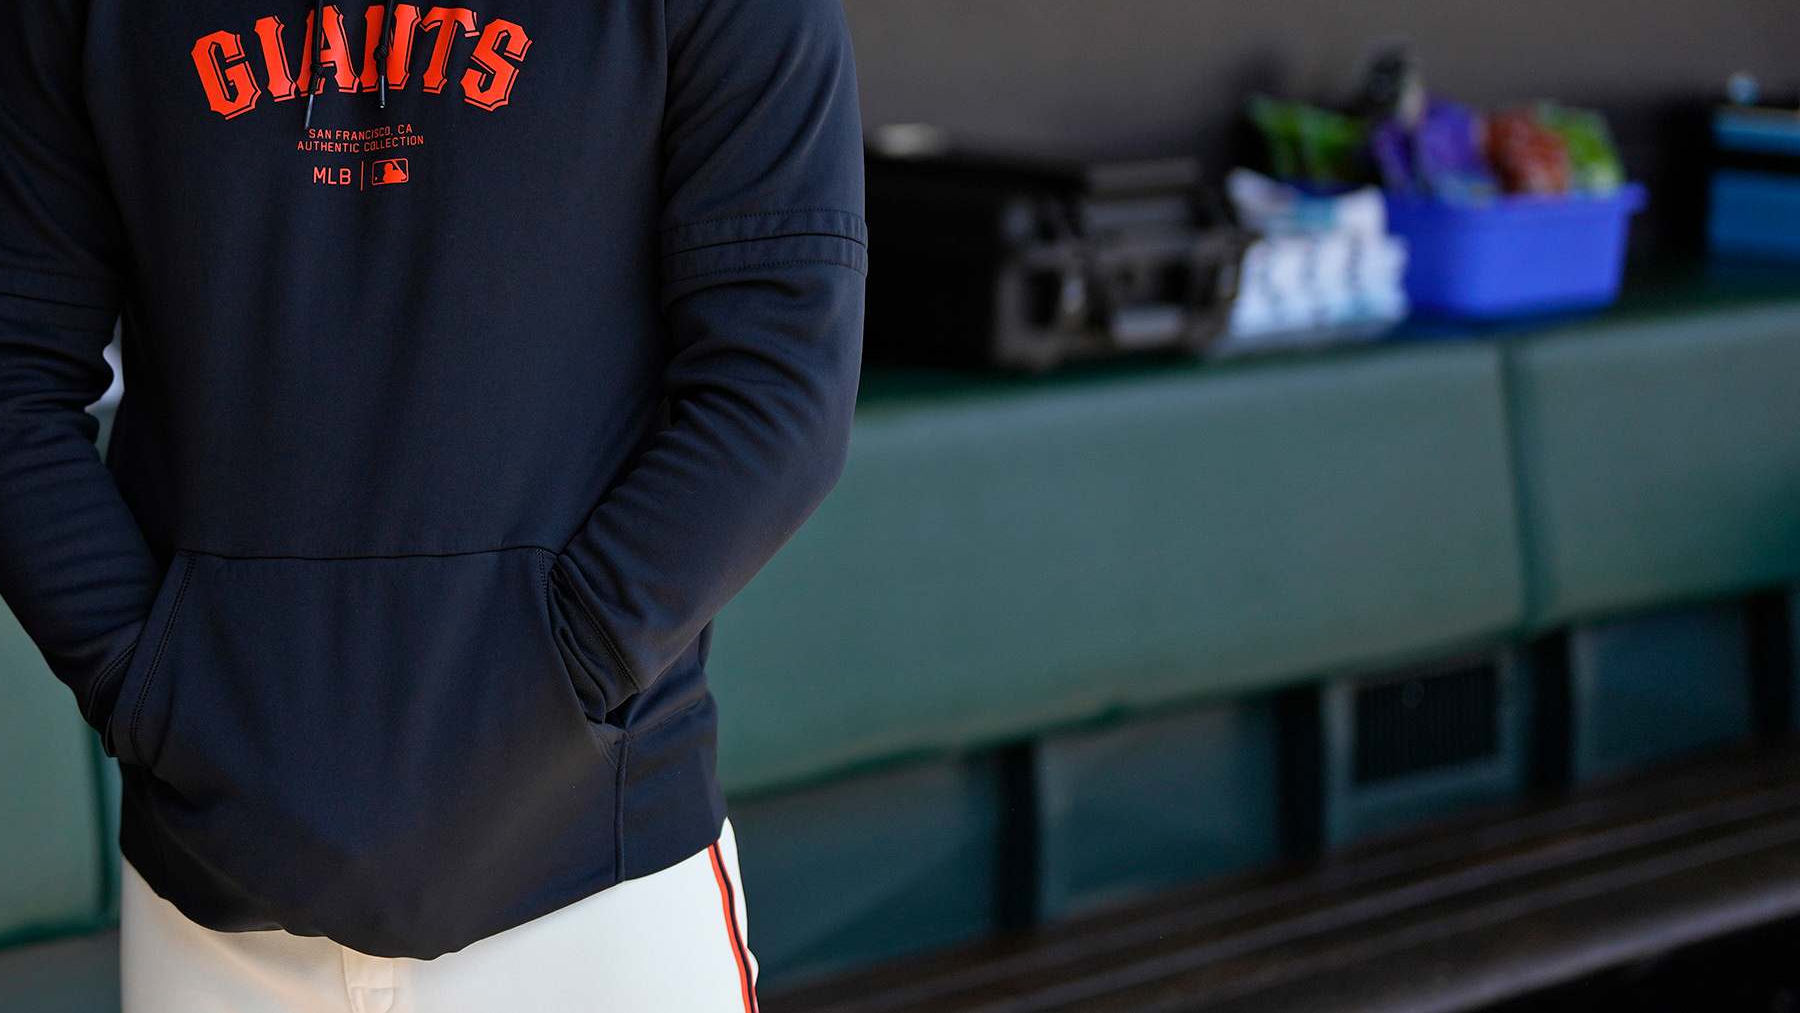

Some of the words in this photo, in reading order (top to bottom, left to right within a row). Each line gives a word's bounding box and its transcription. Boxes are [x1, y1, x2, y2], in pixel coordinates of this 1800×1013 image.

[190, 3, 533, 121] GIANTS
[308, 128, 332, 140] SAN
[397, 123, 413, 135] CA
[297, 140, 360, 153] AUTHENTIC
[363, 135, 424, 152] COLLECTION
[313, 166, 352, 185] MLB
